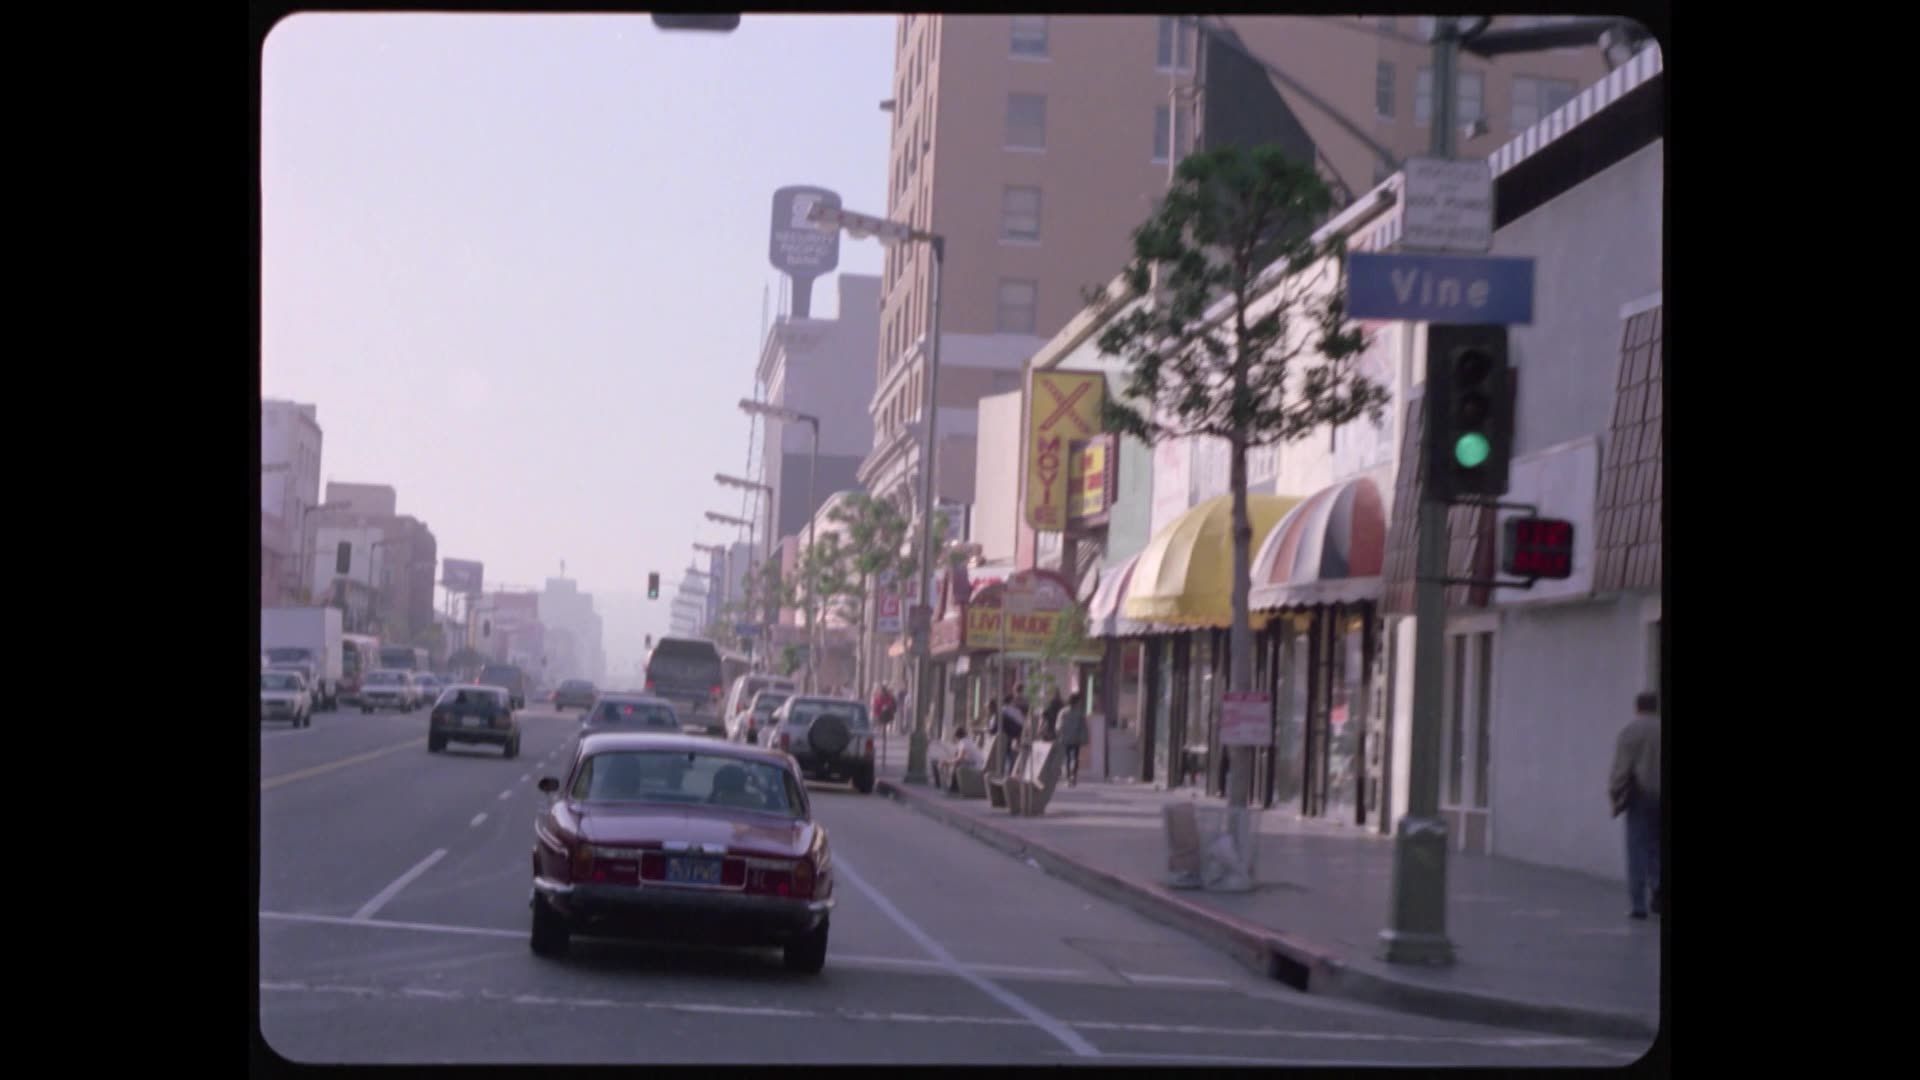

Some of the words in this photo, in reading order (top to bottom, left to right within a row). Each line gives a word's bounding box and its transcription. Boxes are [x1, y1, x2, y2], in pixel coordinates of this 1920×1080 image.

[1391, 267, 1490, 309] Vine
[1040, 378, 1091, 433] X
[1034, 435, 1060, 525] MOVIE
